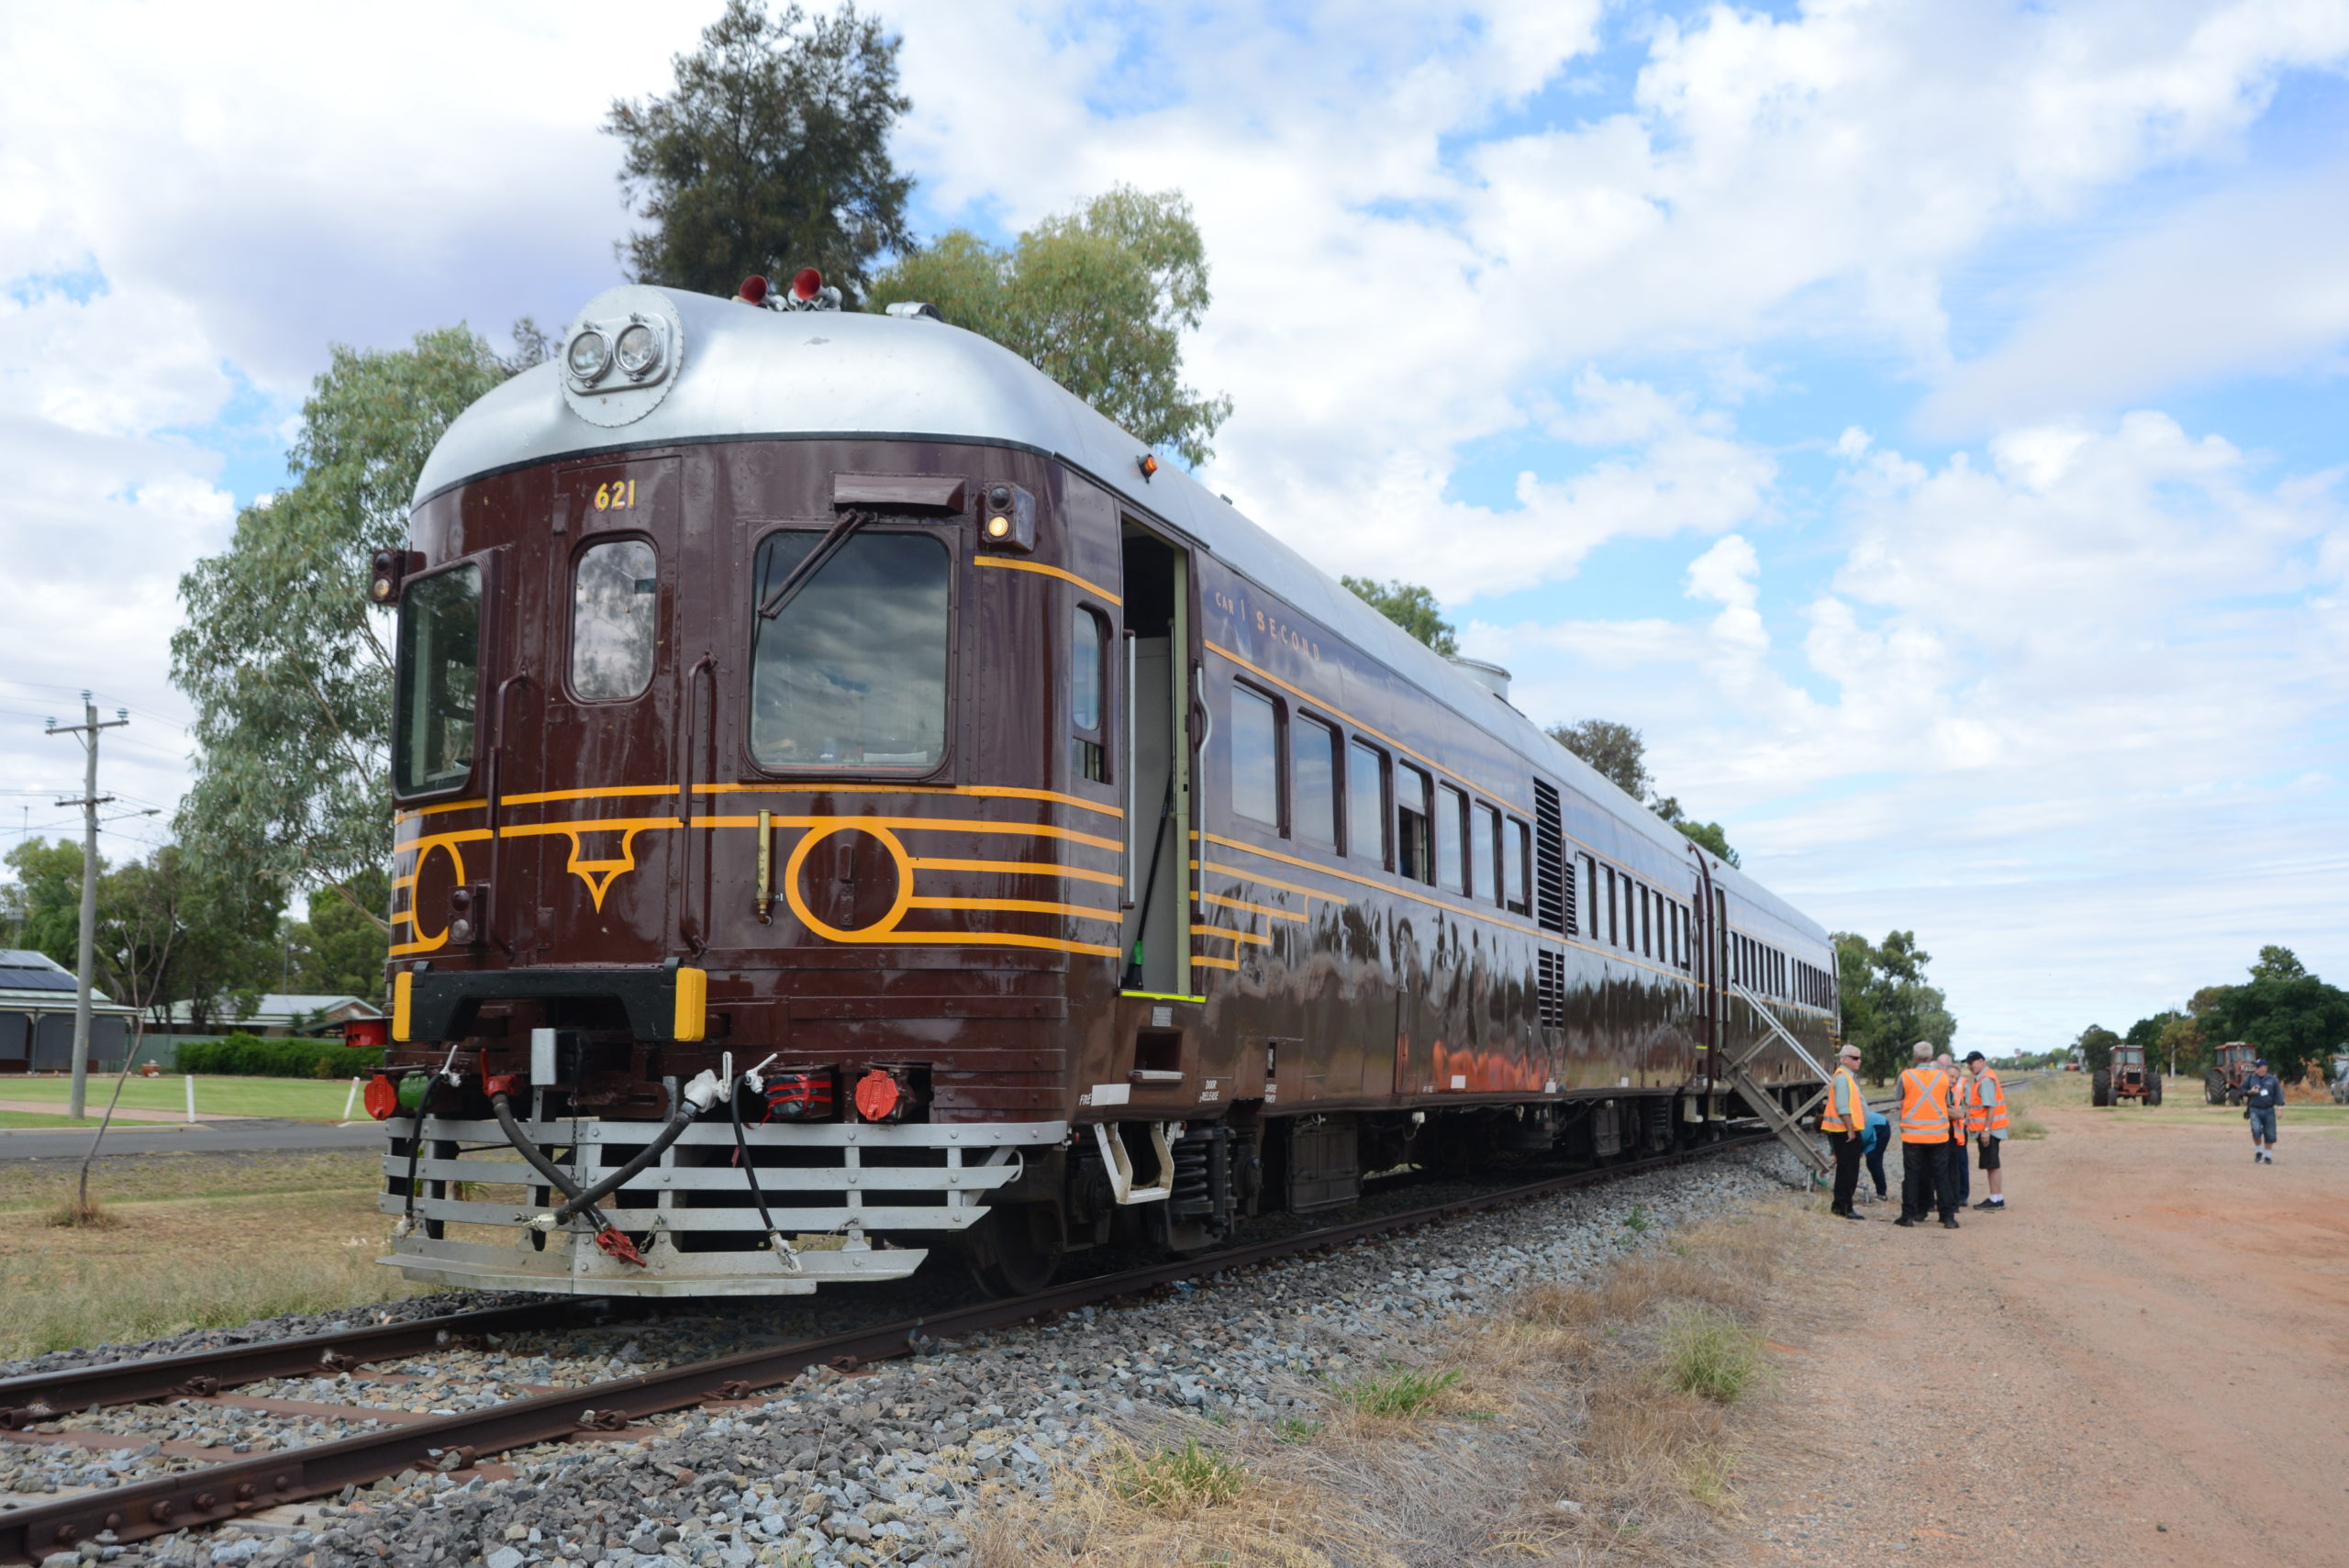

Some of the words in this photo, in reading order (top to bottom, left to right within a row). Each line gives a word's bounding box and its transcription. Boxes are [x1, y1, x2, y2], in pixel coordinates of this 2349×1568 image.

[594, 478, 636, 513] 621
[1215, 591, 1234, 615] CAR
[1256, 610, 1320, 662] SECOND
[1079, 1094, 1092, 1106] FIRE
